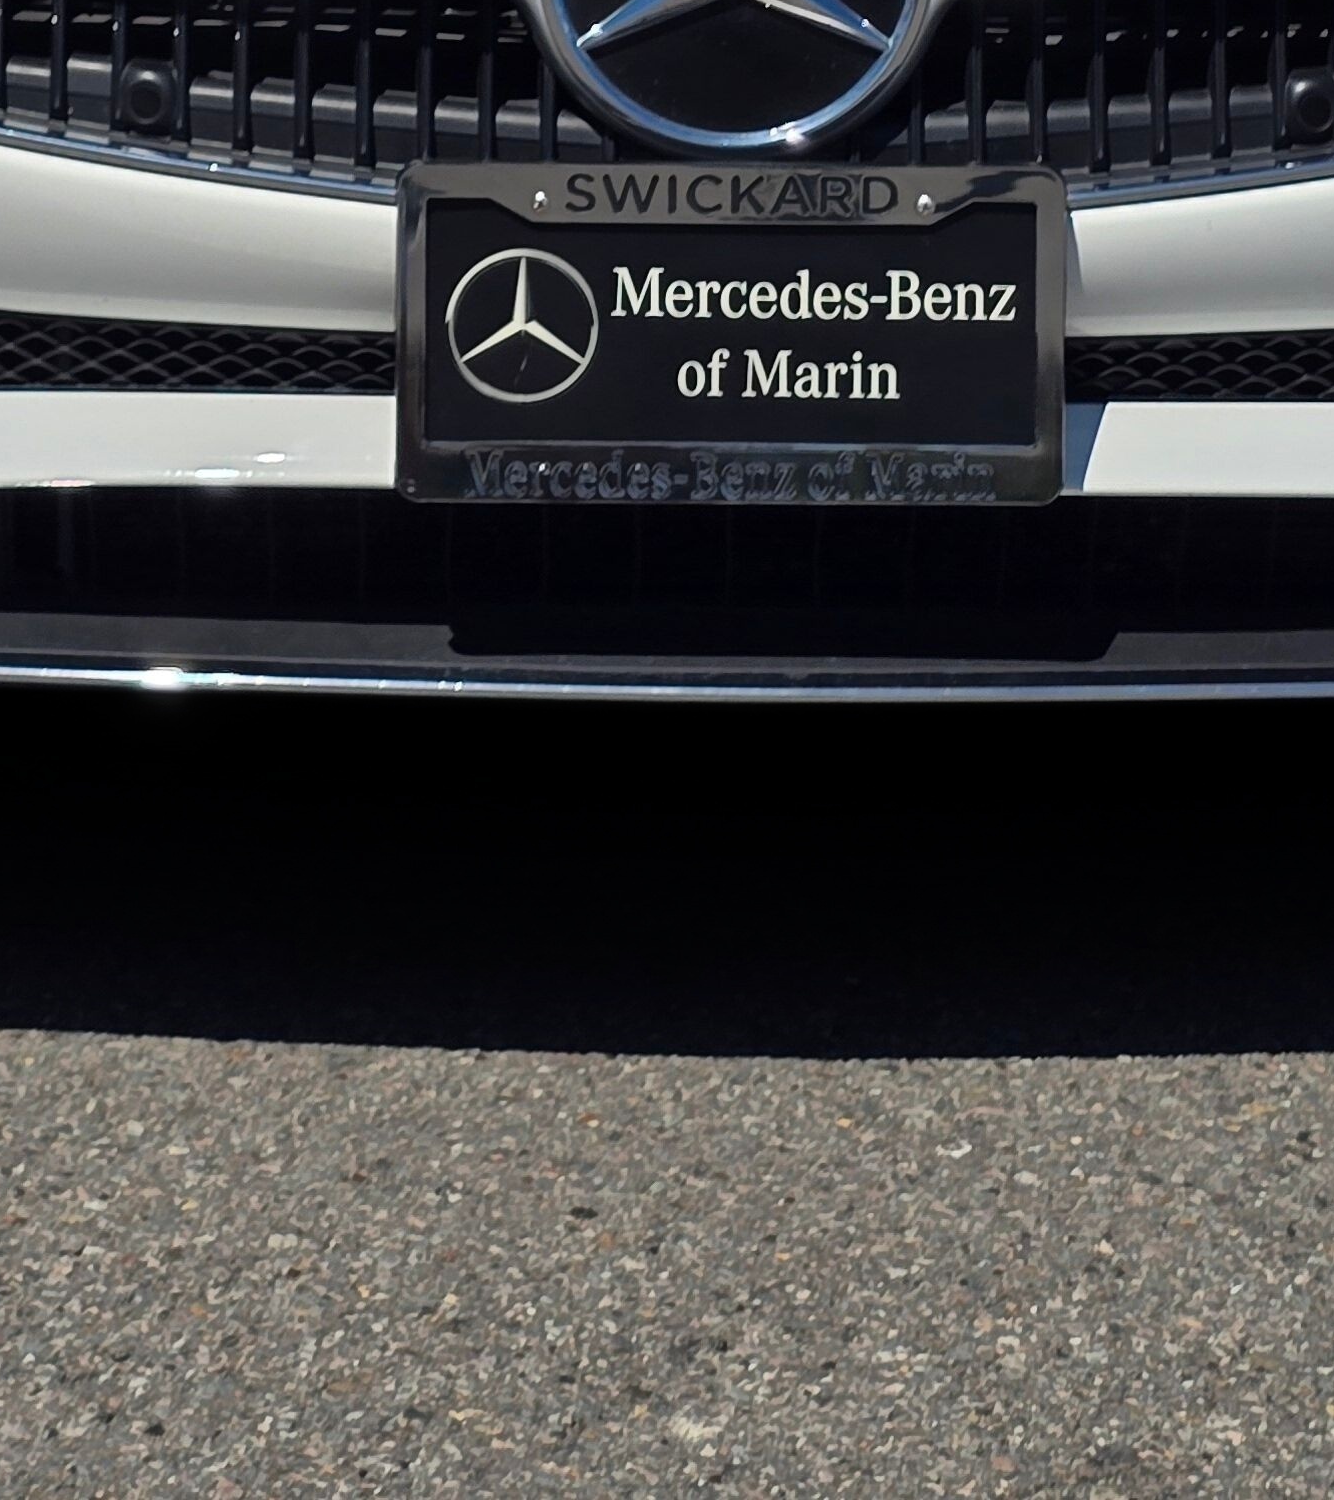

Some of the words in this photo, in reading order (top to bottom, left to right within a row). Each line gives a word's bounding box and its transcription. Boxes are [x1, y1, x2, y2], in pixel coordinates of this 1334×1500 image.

[565, 173, 899, 215] SWICKARD
[610, 266, 1017, 321] Mercedes-Benz
[677, 347, 730, 397] of
[741, 349, 901, 399] Marin
[464, 449, 797, 500] Mercedes-Benz
[807, 451, 857, 501] of
